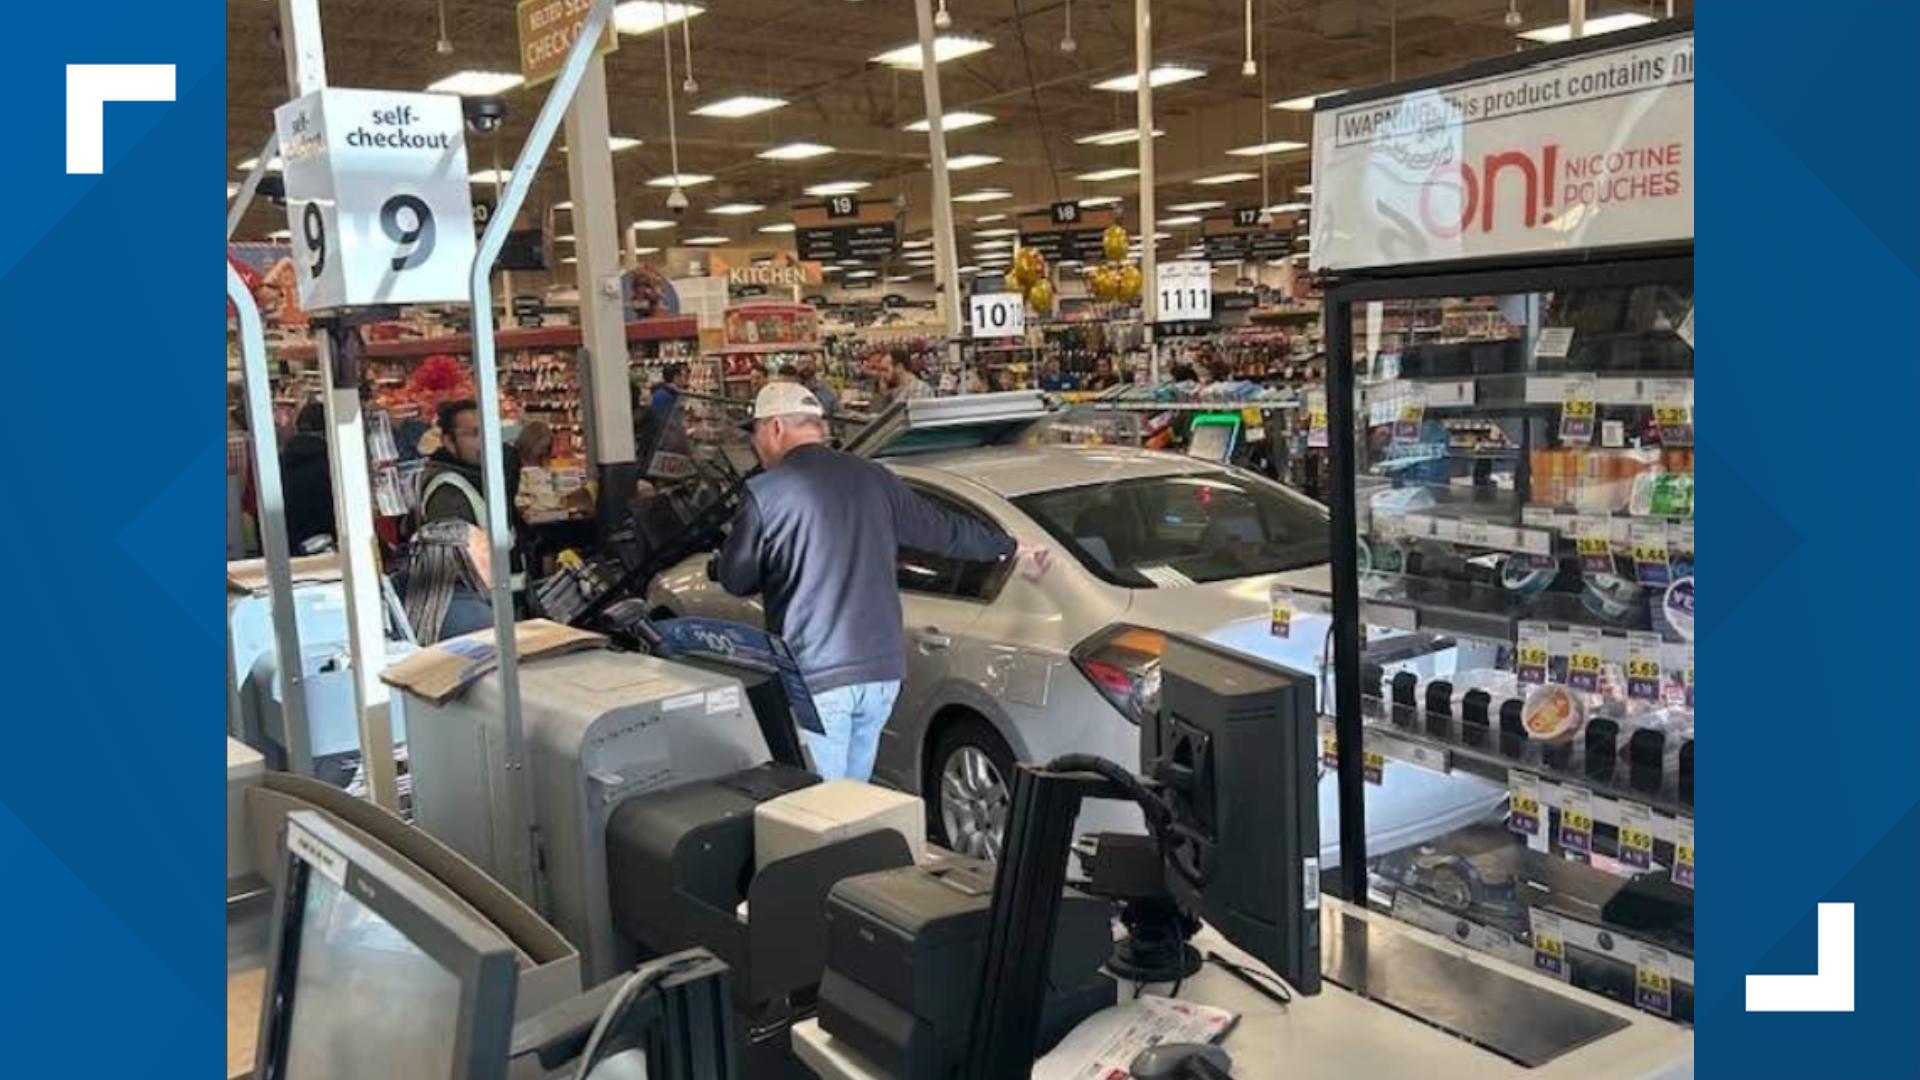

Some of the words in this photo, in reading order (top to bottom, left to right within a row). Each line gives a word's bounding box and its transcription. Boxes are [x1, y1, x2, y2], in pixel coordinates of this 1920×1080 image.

[527, 26, 571, 65] CHECK
[1483, 80, 1561, 118] product
[1567, 55, 1665, 96] contains
[372, 105, 420, 125] self-
[346, 126, 450, 149] checkout
[1565, 144, 1682, 179] NICOTINE
[1419, 144, 1558, 240] on!
[1564, 170, 1681, 206] POUCHES
[832, 196, 853, 214] 19
[1057, 205, 1075, 221] 18
[1240, 210, 1256, 224] 17
[303, 202, 325, 279] 9
[380, 194, 437, 272] 9
[729, 266, 807, 286] KITCHEN
[1160, 289, 1182, 313] 11
[1189, 287, 1207, 310] 11
[975, 303, 1007, 329] 10
[1572, 654, 1599, 670] 5.69
